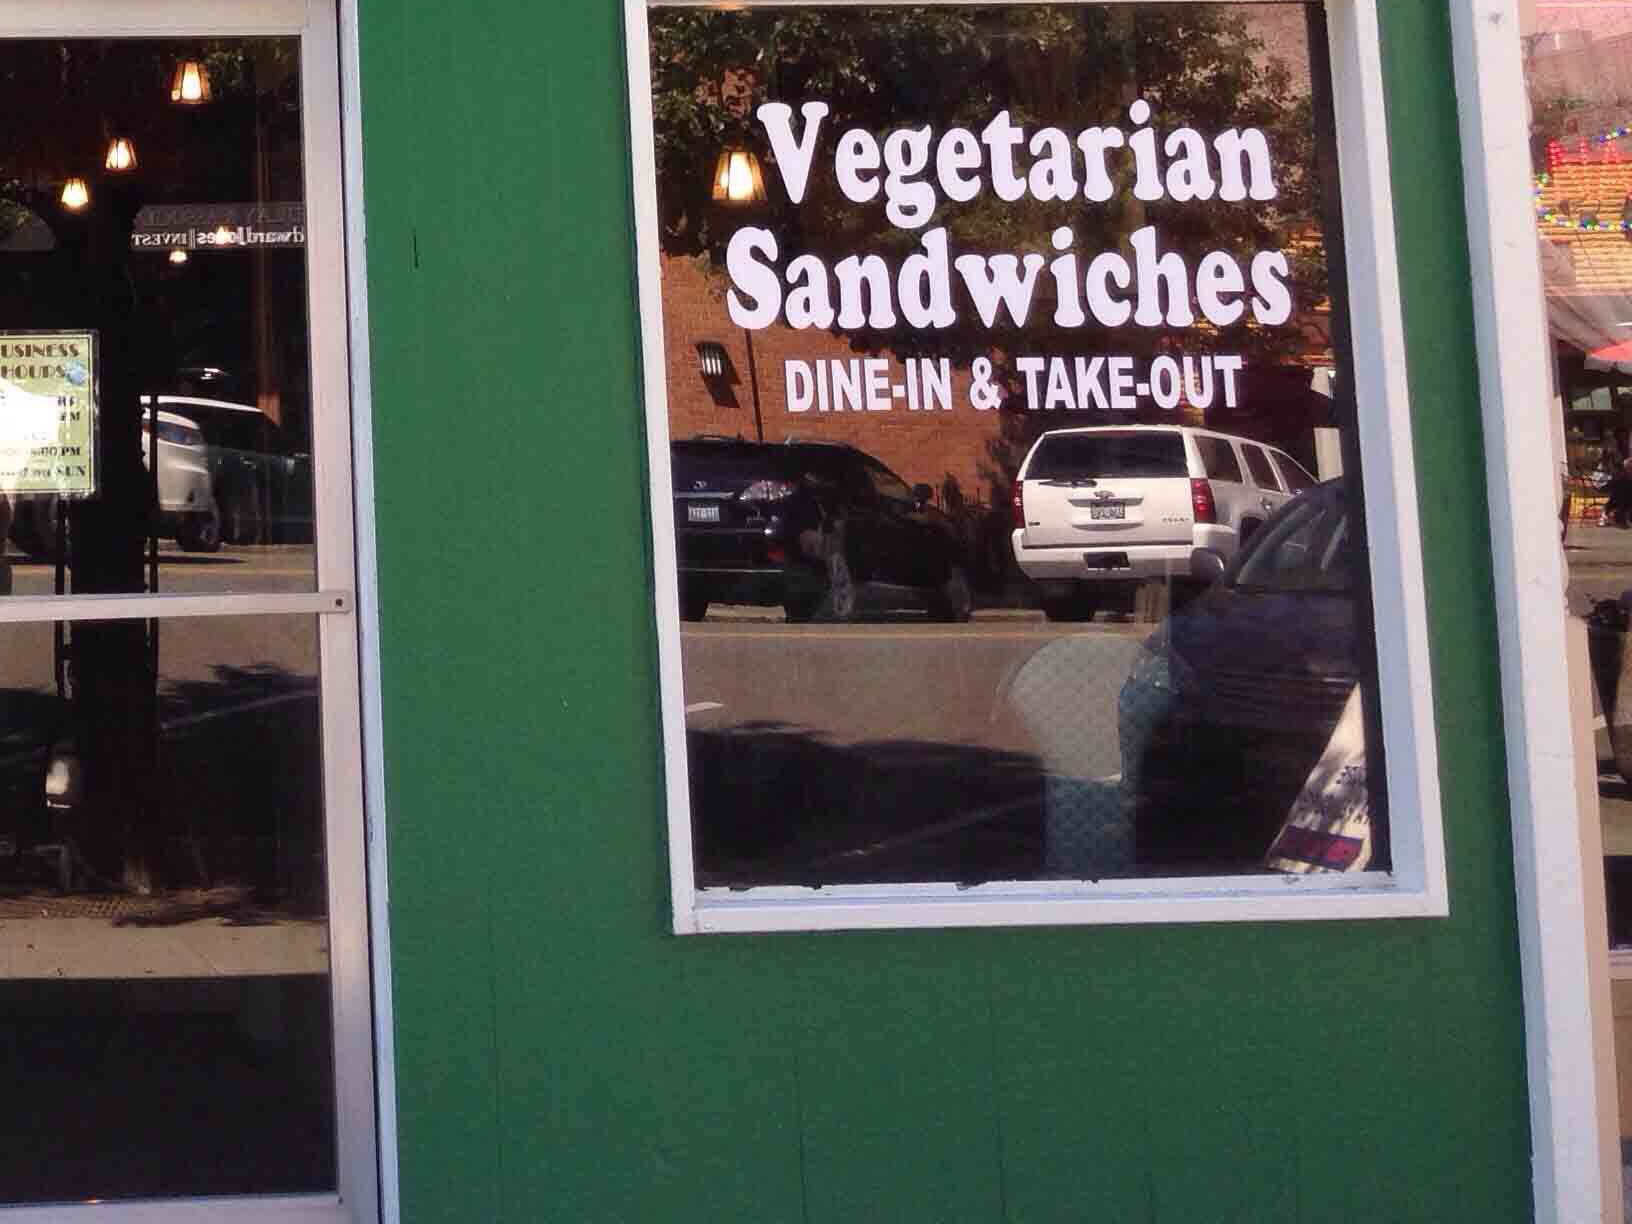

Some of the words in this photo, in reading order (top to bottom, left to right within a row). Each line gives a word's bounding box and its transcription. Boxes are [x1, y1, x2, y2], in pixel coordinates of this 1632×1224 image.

[756, 98, 1278, 230] Vegetarian
[725, 225, 1292, 331] Sandwiches
[785, 357, 953, 413] DINE-IN
[970, 358, 1003, 410] &
[1016, 354, 1244, 410] TAKE-OUT
